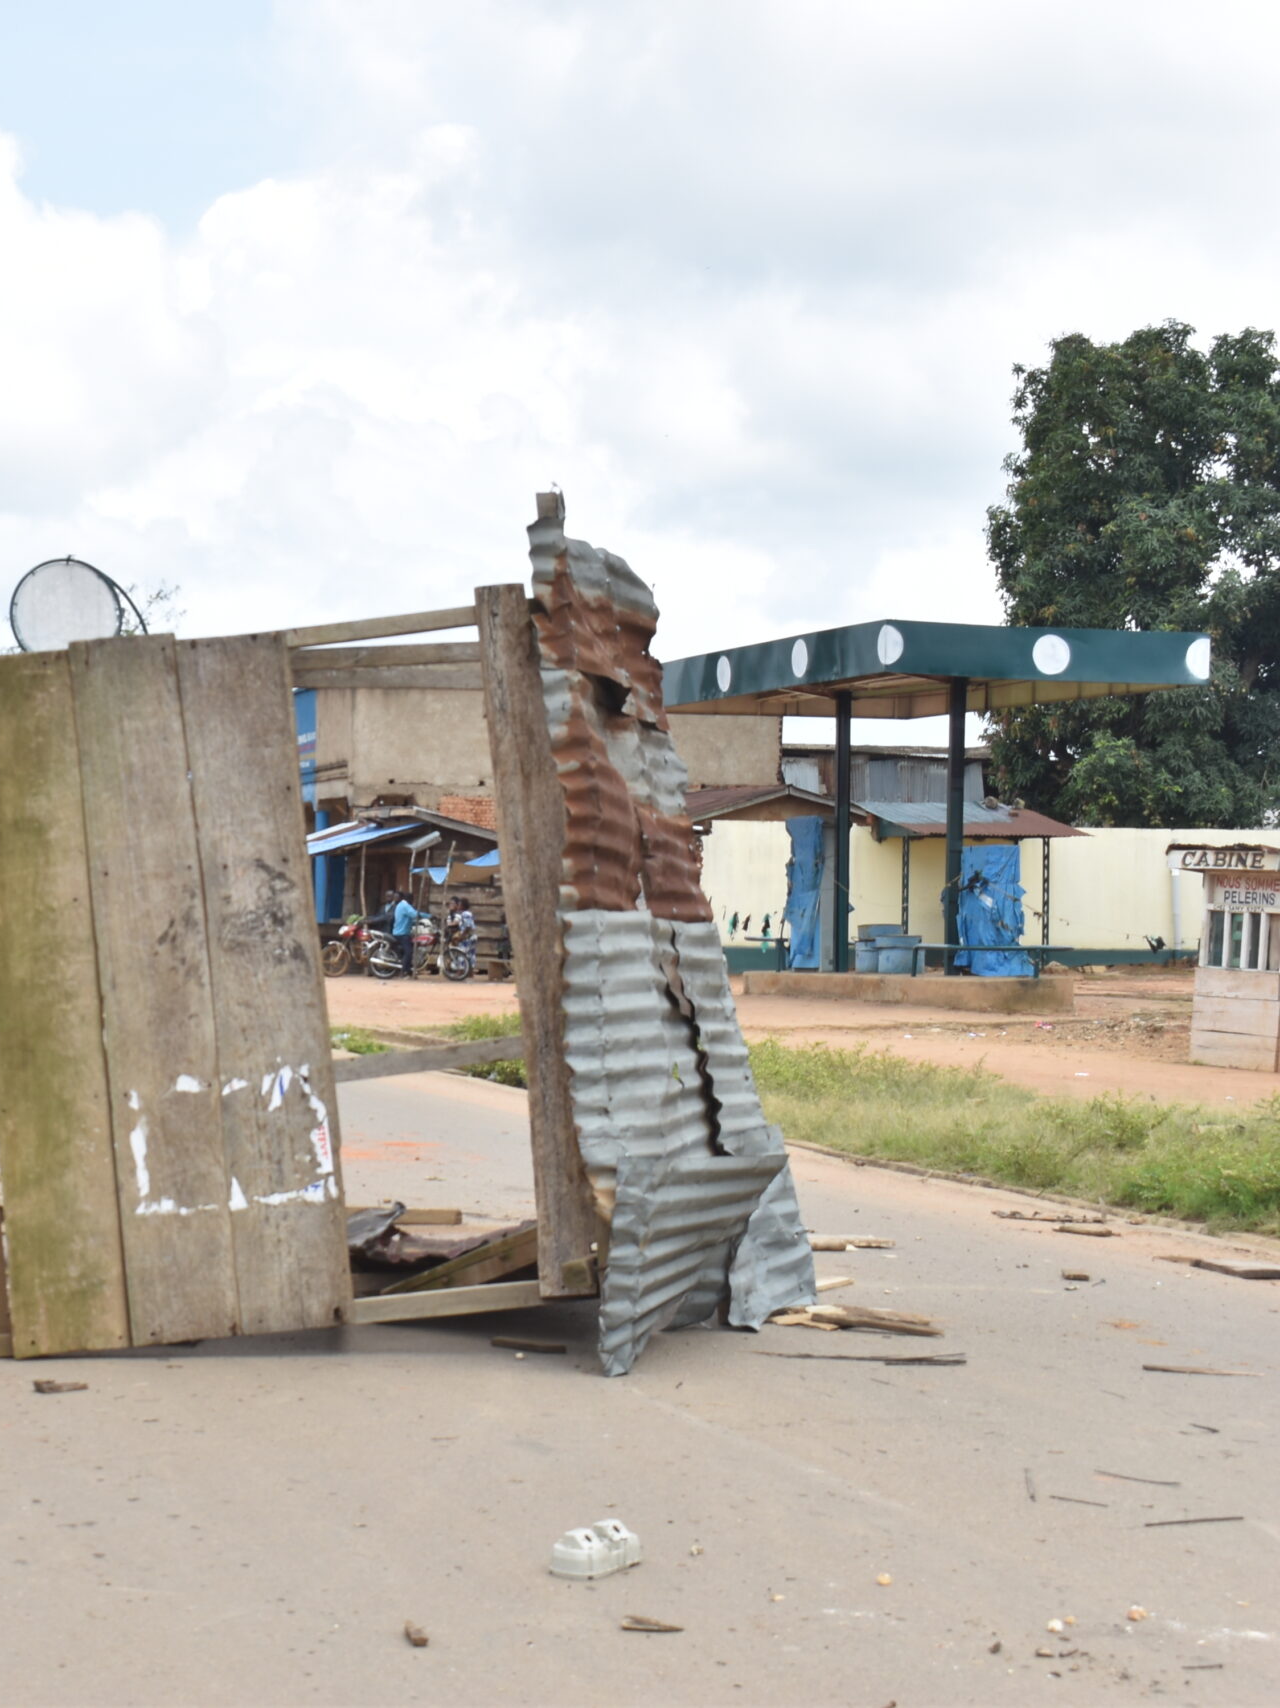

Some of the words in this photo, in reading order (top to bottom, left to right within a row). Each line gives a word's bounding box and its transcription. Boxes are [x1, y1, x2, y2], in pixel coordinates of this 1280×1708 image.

[1182, 851, 1265, 869] CABINE
[1216, 875, 1240, 889] NOUS
[1224, 890, 1276, 905] PELERINS
